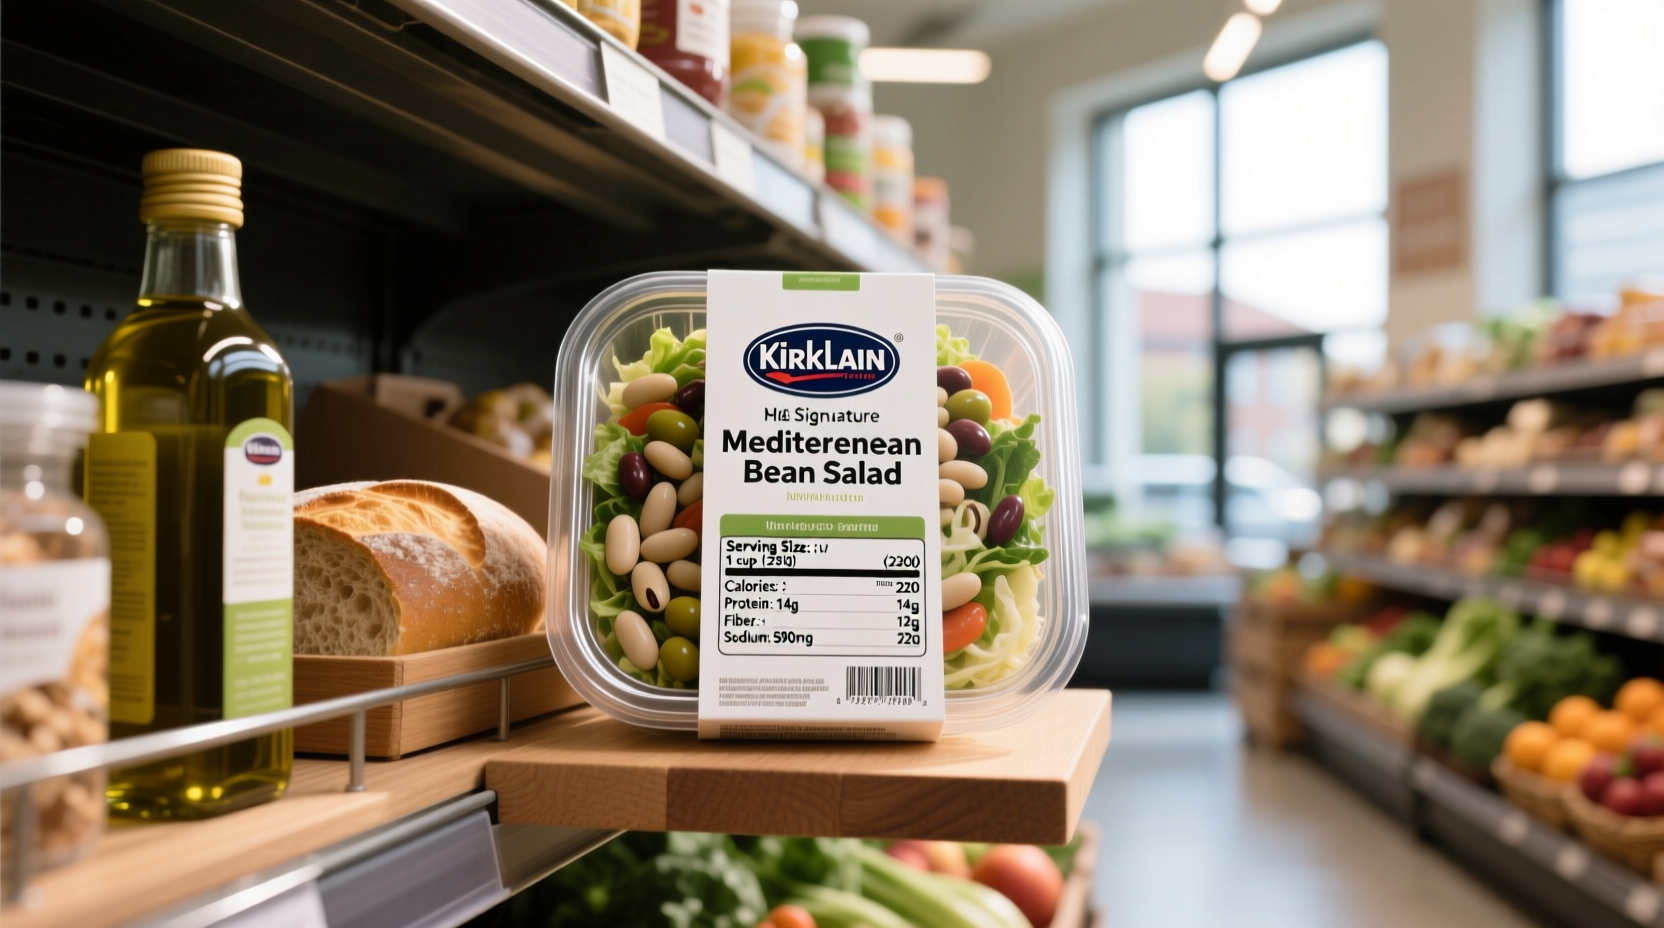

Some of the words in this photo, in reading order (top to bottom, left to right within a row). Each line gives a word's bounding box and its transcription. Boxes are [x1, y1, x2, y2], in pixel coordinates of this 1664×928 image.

[722, 429, 922, 455] Mediterenean
[743, 460, 815, 484] Bean
[823, 460, 902, 485] Salad
[726, 540, 777, 555] Serving
[726, 555, 732, 565] 1
[736, 557, 757, 569] cup
[896, 581, 920, 593] 220
[724, 596, 774, 610] Protein:
[776, 597, 799, 614] 14g
[897, 599, 919, 615] 14g
[897, 615, 920, 632] 12g
